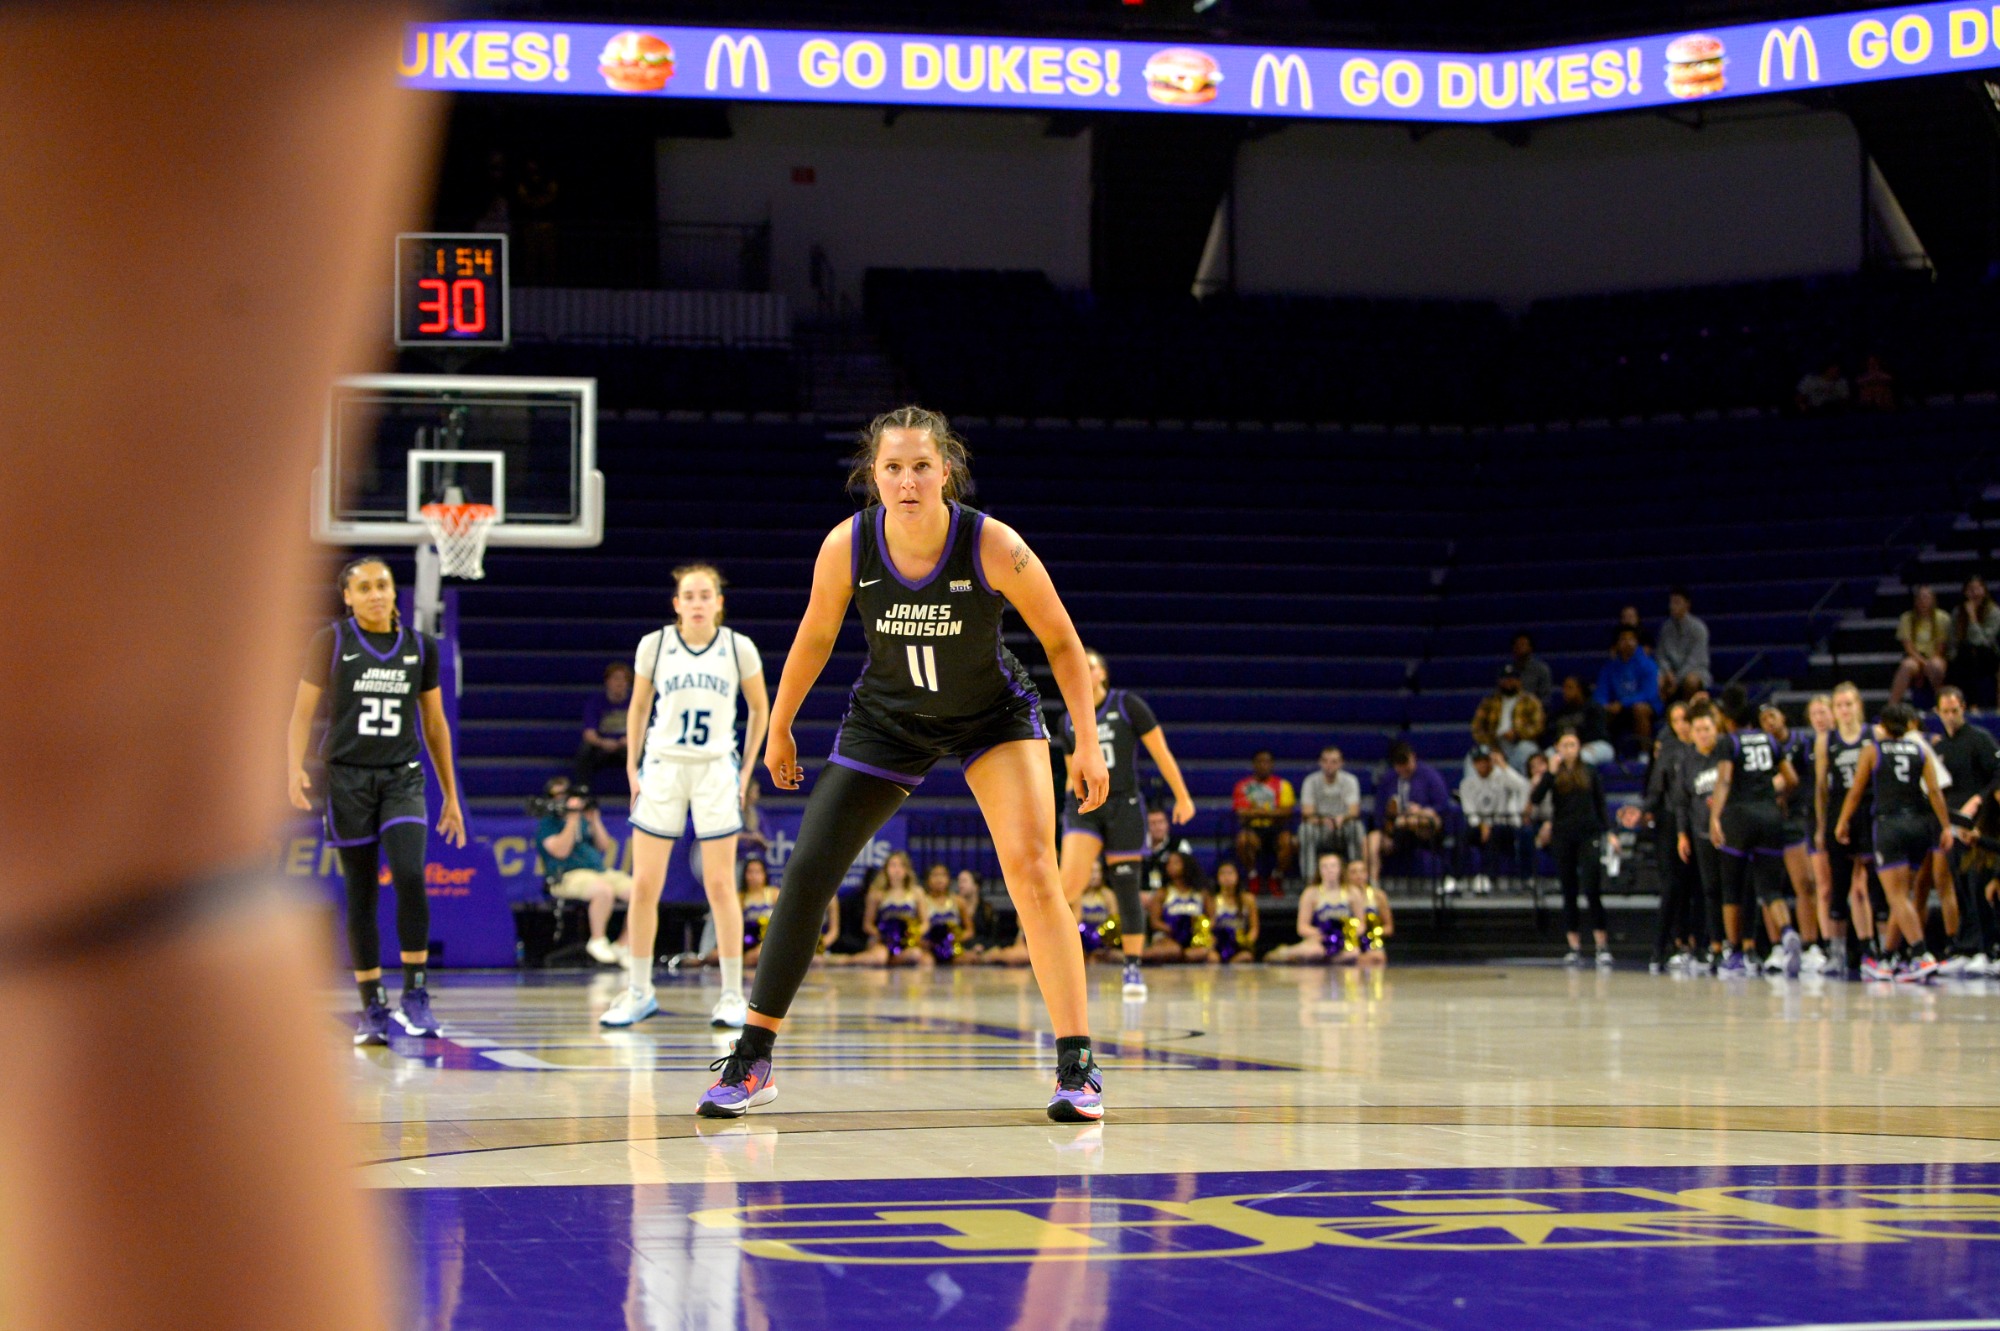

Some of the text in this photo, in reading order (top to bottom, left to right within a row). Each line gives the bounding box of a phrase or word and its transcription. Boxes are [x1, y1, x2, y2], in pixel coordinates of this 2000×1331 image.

[1848, 14, 1933, 70] GO
[799, 38, 1121, 97] GO DUKES!
[1340, 46, 1642, 110] GO DUKES!
[418, 278, 486, 333] 30
[875, 618, 963, 637] MADISON
[885, 603, 952, 620] JAMES
[362, 667, 407, 681] JAMES
[665, 672, 730, 698] MAINE
[905, 645, 939, 692] 11
[353, 679, 411, 694] MADISON
[358, 697, 402, 736] 25
[676, 709, 712, 746] 15
[1742, 744, 1774, 772] 30
[1893, 754, 1911, 783] 2
